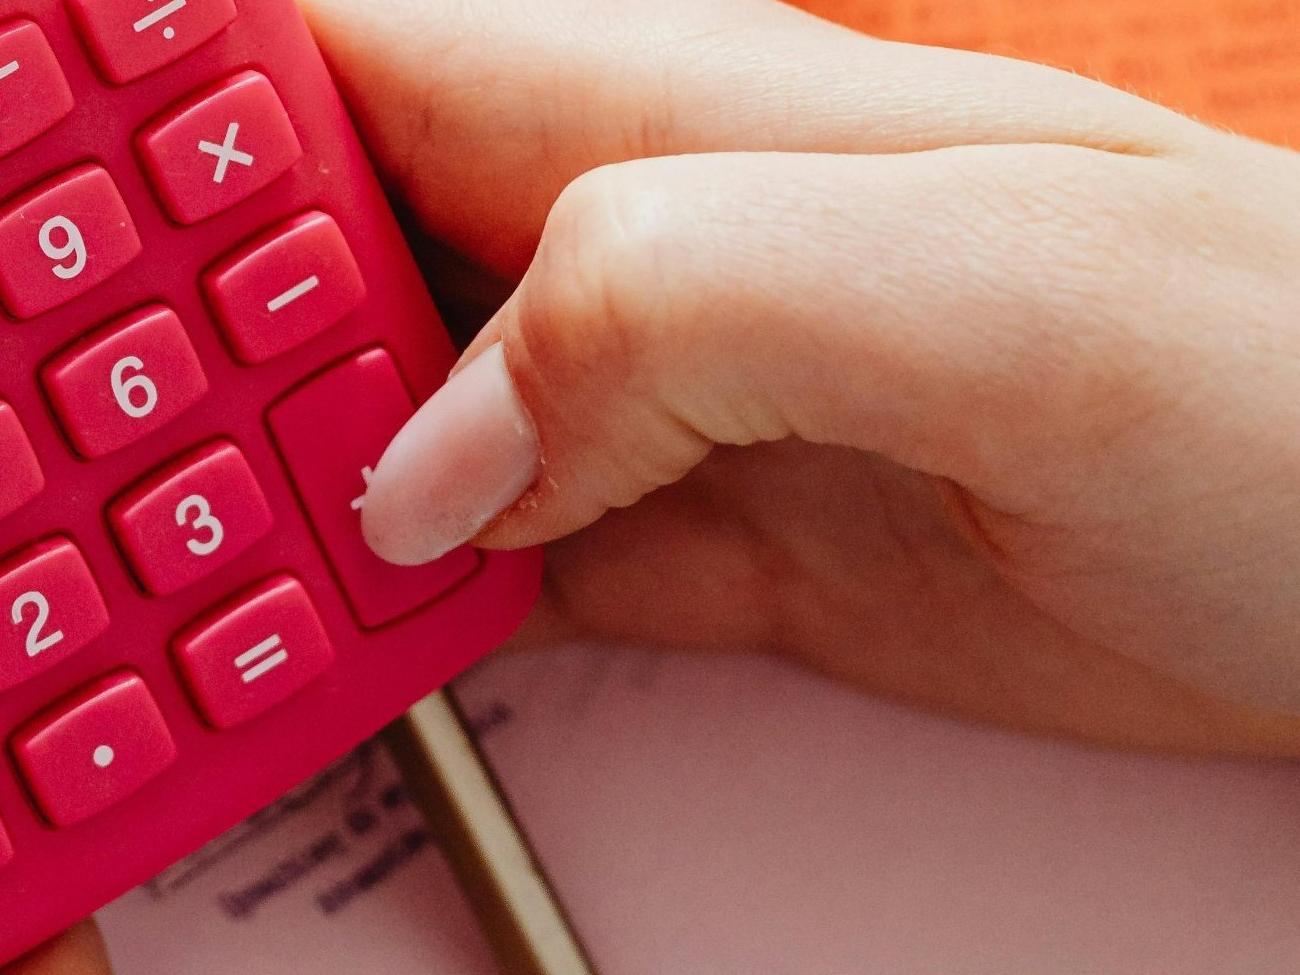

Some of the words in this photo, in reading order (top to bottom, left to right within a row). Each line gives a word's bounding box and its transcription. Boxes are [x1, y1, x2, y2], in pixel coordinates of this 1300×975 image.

[39, 215, 86, 279] 9
[111, 356, 157, 417] 6
[176, 495, 223, 555] 3
[12, 592, 63, 656] 2
